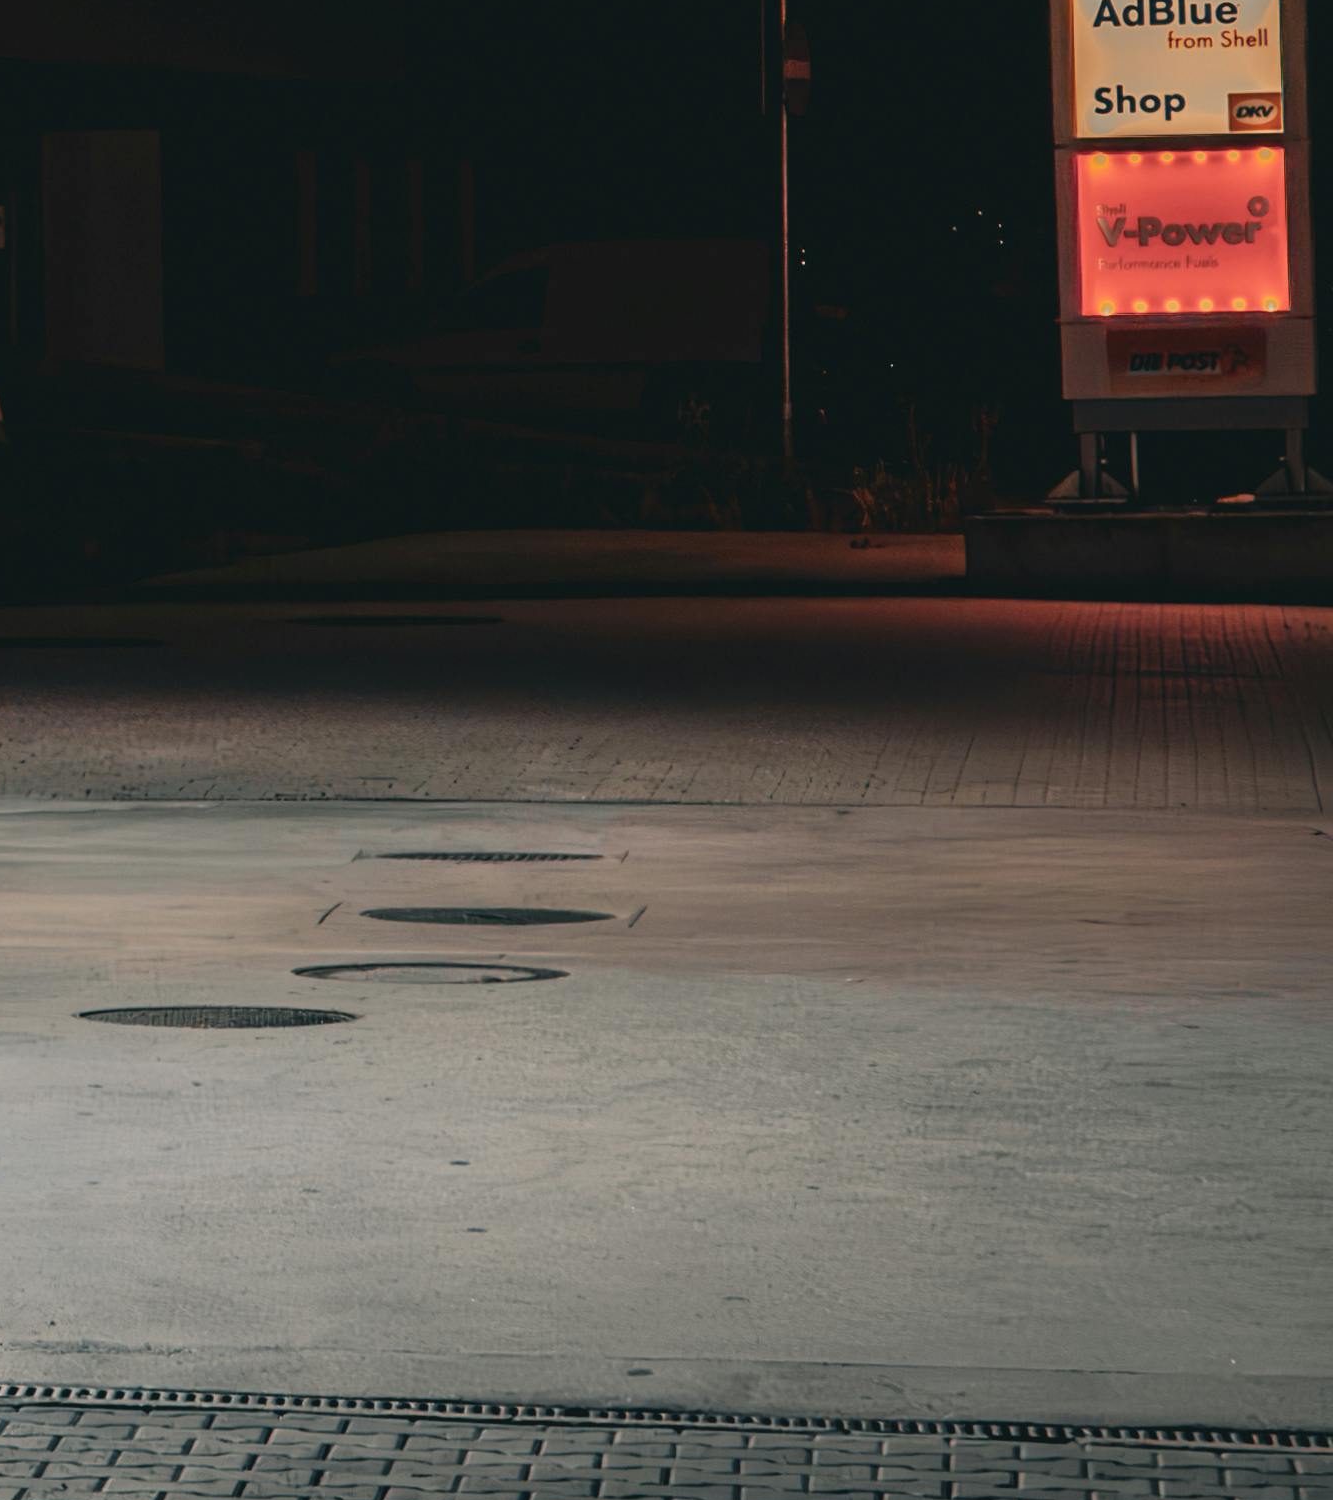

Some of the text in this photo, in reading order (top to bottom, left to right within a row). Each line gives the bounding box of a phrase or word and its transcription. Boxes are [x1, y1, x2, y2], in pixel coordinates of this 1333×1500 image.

[1168, 28, 1268, 49] from Shell
[1094, 85, 1186, 121] Shop
[1236, 105, 1274, 118] DKV
[1096, 216, 1263, 247] V-Power
[1166, 351, 1220, 371] POST
